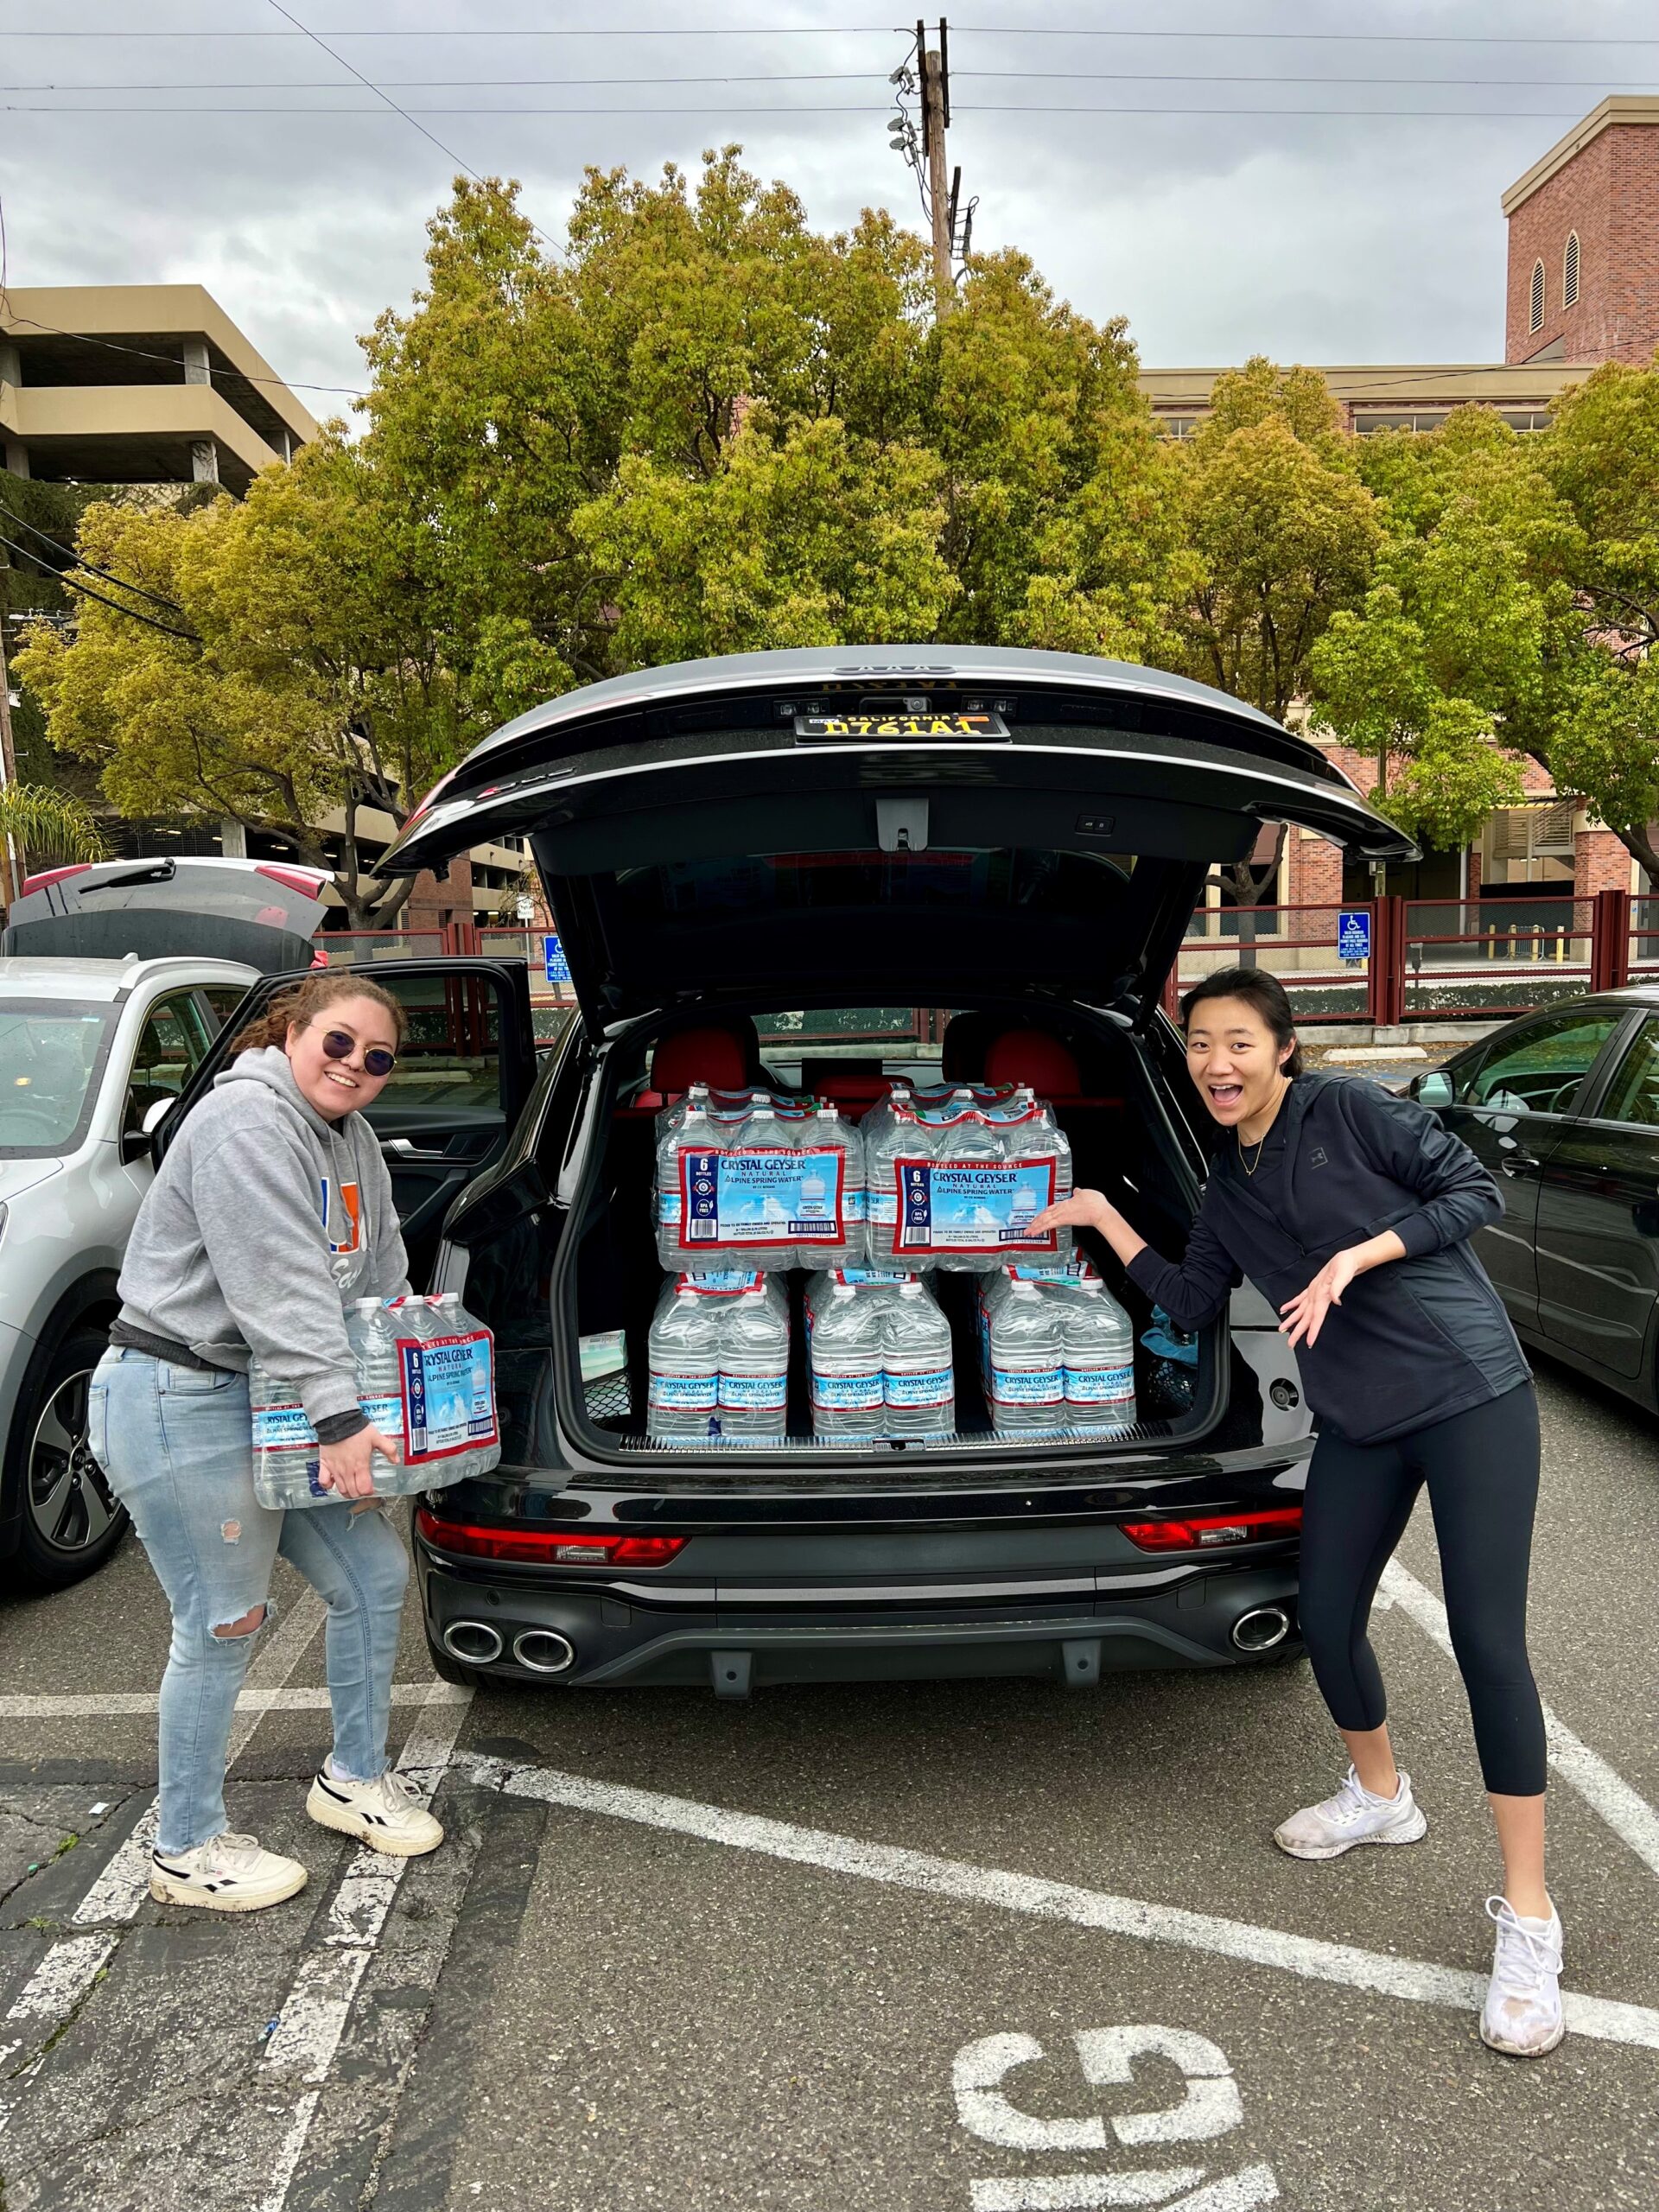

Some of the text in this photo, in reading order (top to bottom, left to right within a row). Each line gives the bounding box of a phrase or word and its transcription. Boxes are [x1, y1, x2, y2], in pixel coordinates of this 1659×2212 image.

[700, 1158, 709, 1171] 6
[721, 1159, 805, 1171] CRYSTAL GEYSER
[725, 1175, 751, 1184] ALPINE
[913, 1170, 921, 1182] 6
[933, 1173, 1017, 1183] CRYSTAL GEYSER
[412, 1352, 418, 1368] 6
[855, 1379, 880, 1389] GEYSER
[1033, 1375, 1058, 1384] GEYSER
[729, 1381, 783, 1389] CRYSTAL GEYSER
[362, 1403, 388, 1414] EYSER
